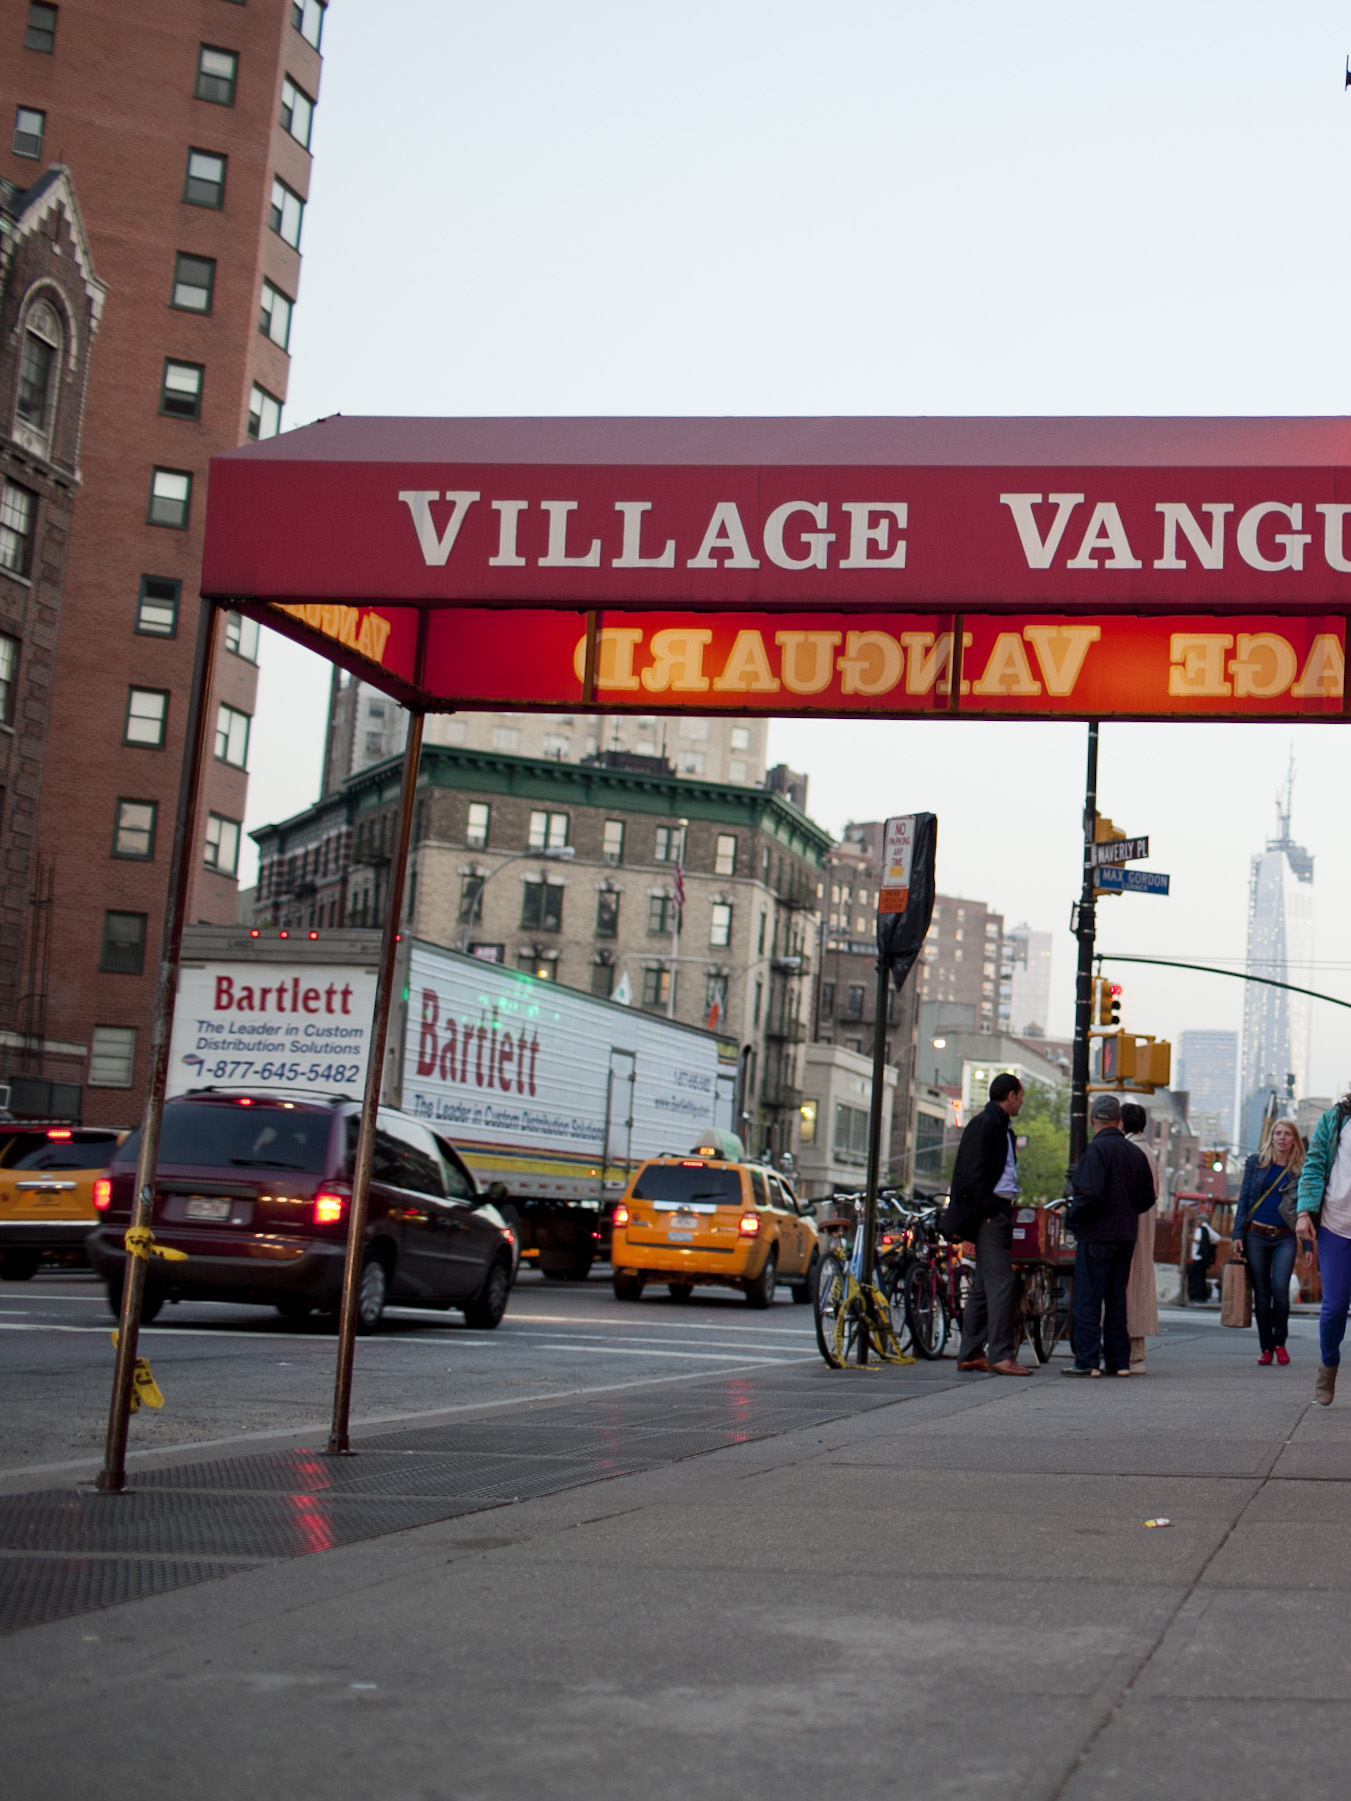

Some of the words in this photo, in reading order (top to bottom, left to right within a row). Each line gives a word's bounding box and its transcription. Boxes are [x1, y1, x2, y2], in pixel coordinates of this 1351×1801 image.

[399, 490, 908, 570] VILLAGE
[895, 822, 906, 836] NO
[888, 837, 911, 846] PARKING
[1097, 841, 1134, 863] WAVERLY
[1136, 839, 1147, 858] PL
[1102, 868, 1124, 882] MAX
[1128, 871, 1168, 888] GORDON
[213, 975, 353, 1015] Bartlett
[196, 1020, 224, 1034] The
[229, 1022, 282, 1036] Leader
[285, 1024, 299, 1036] in
[304, 1024, 363, 1038] Custom
[196, 1037, 285, 1052] Distribution
[290, 1040, 361, 1055] Solutions
[416, 987, 540, 1097] Bartlett
[195, 1058, 360, 1083] 1-877-645-5482
[414, 1094, 433, 1118] The
[436, 1098, 469, 1122] Leader
[471, 1103, 483, 1123] in
[485, 1105, 519, 1128] Custom
